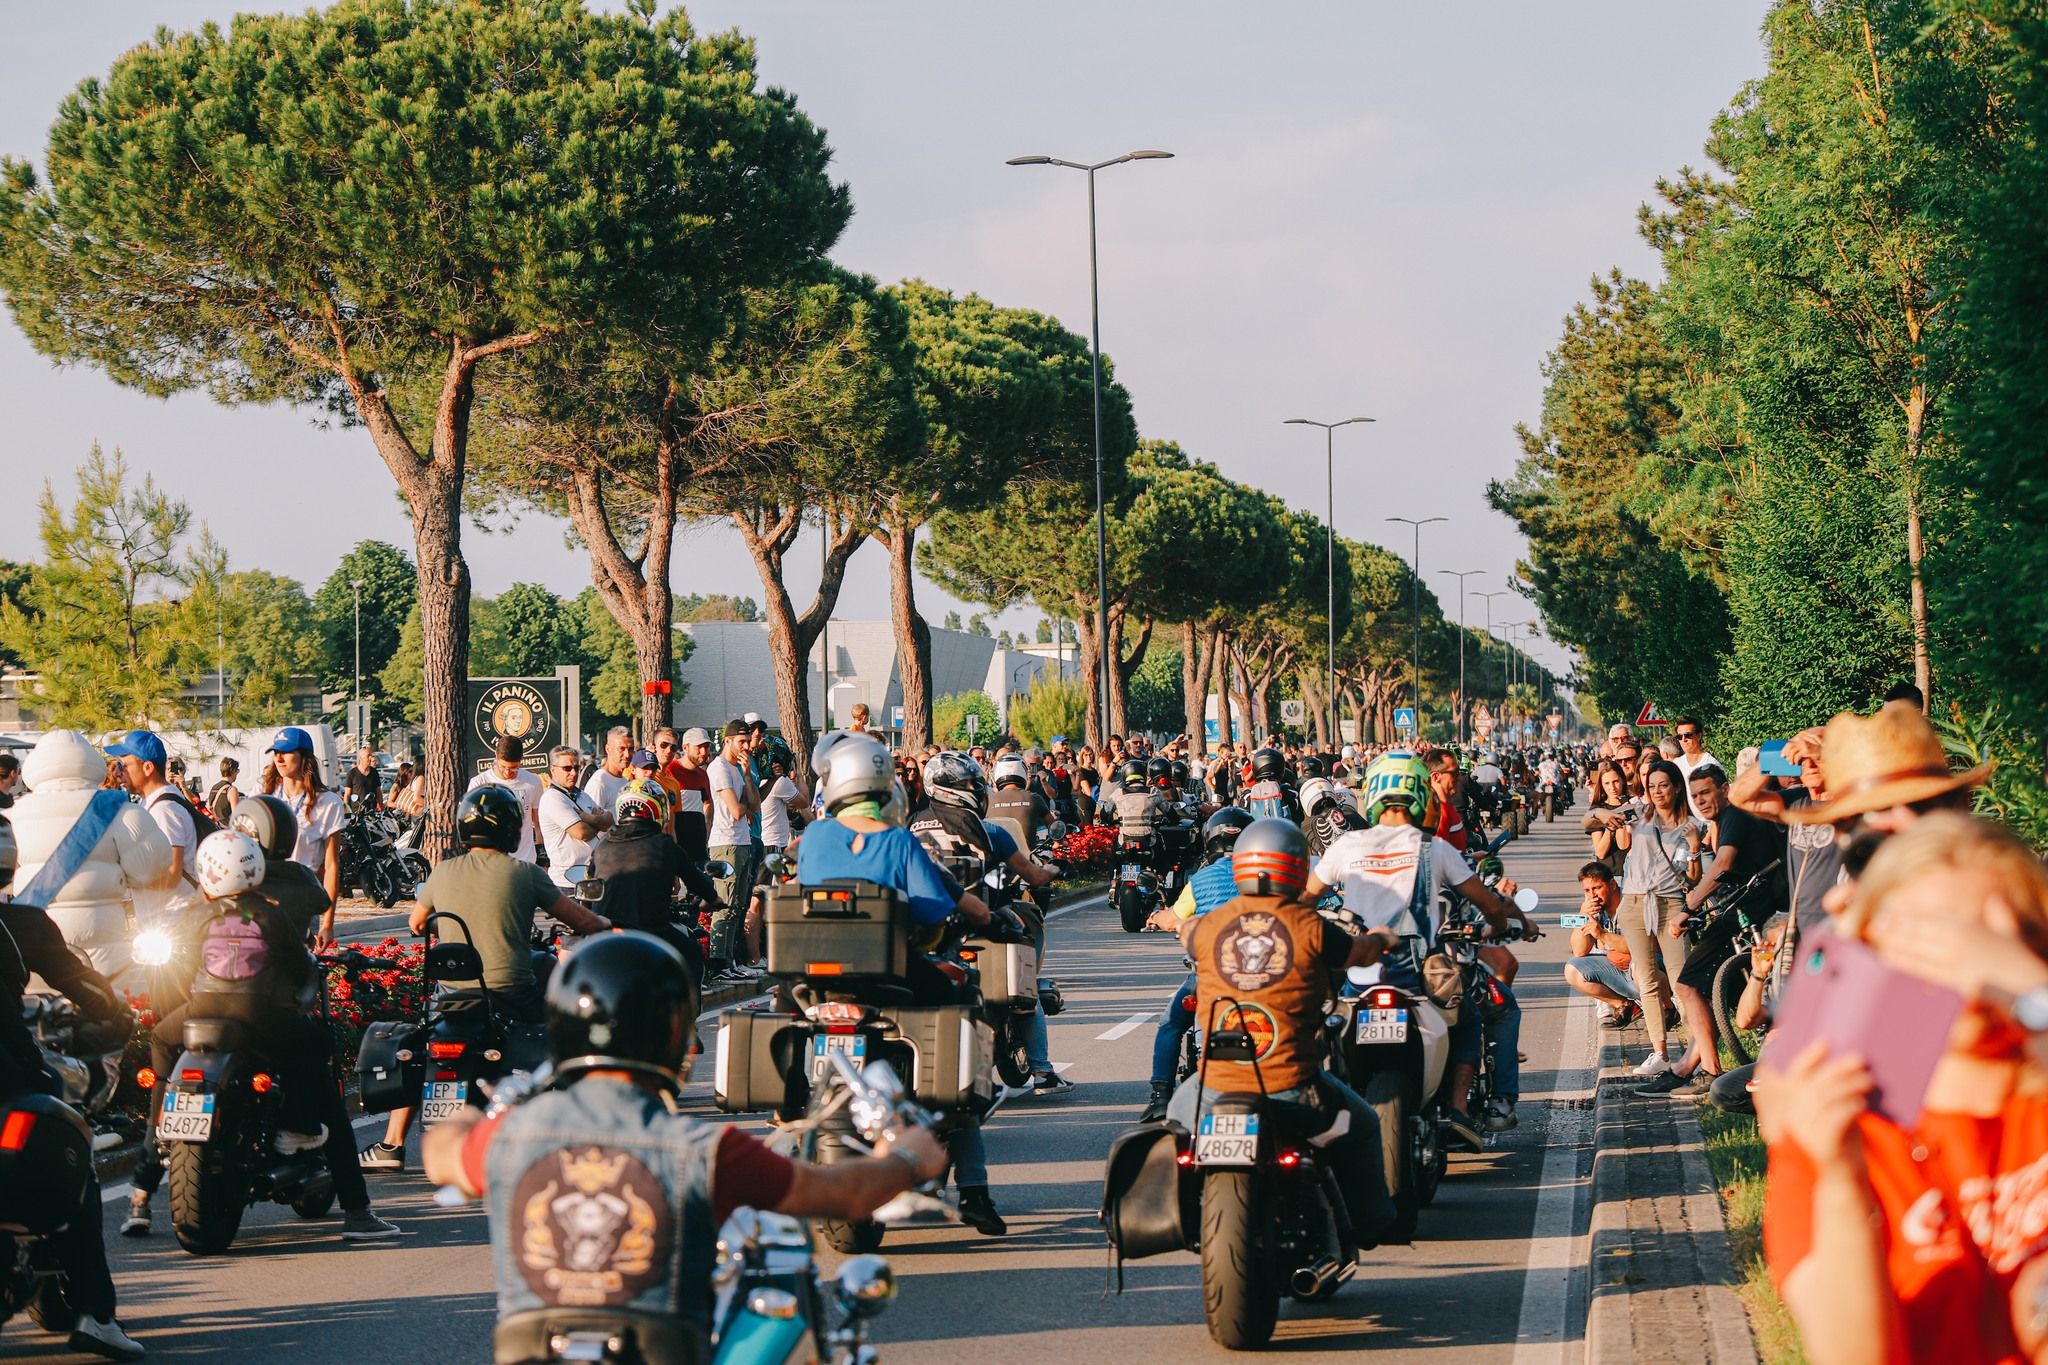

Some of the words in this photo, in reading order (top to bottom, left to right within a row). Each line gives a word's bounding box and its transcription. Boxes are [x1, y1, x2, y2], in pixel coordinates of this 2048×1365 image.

[481, 701, 496, 713] IL
[492, 686, 543, 713] PANINO
[1371, 1010, 1388, 1022] EW
[1360, 1026, 1404, 1039] 28116
[434, 1083, 450, 1098] EP
[176, 1093, 195, 1111] EF
[163, 1116, 209, 1136] 64872
[1214, 1116, 1236, 1134] EH
[1201, 1140, 1253, 1158] 48678
